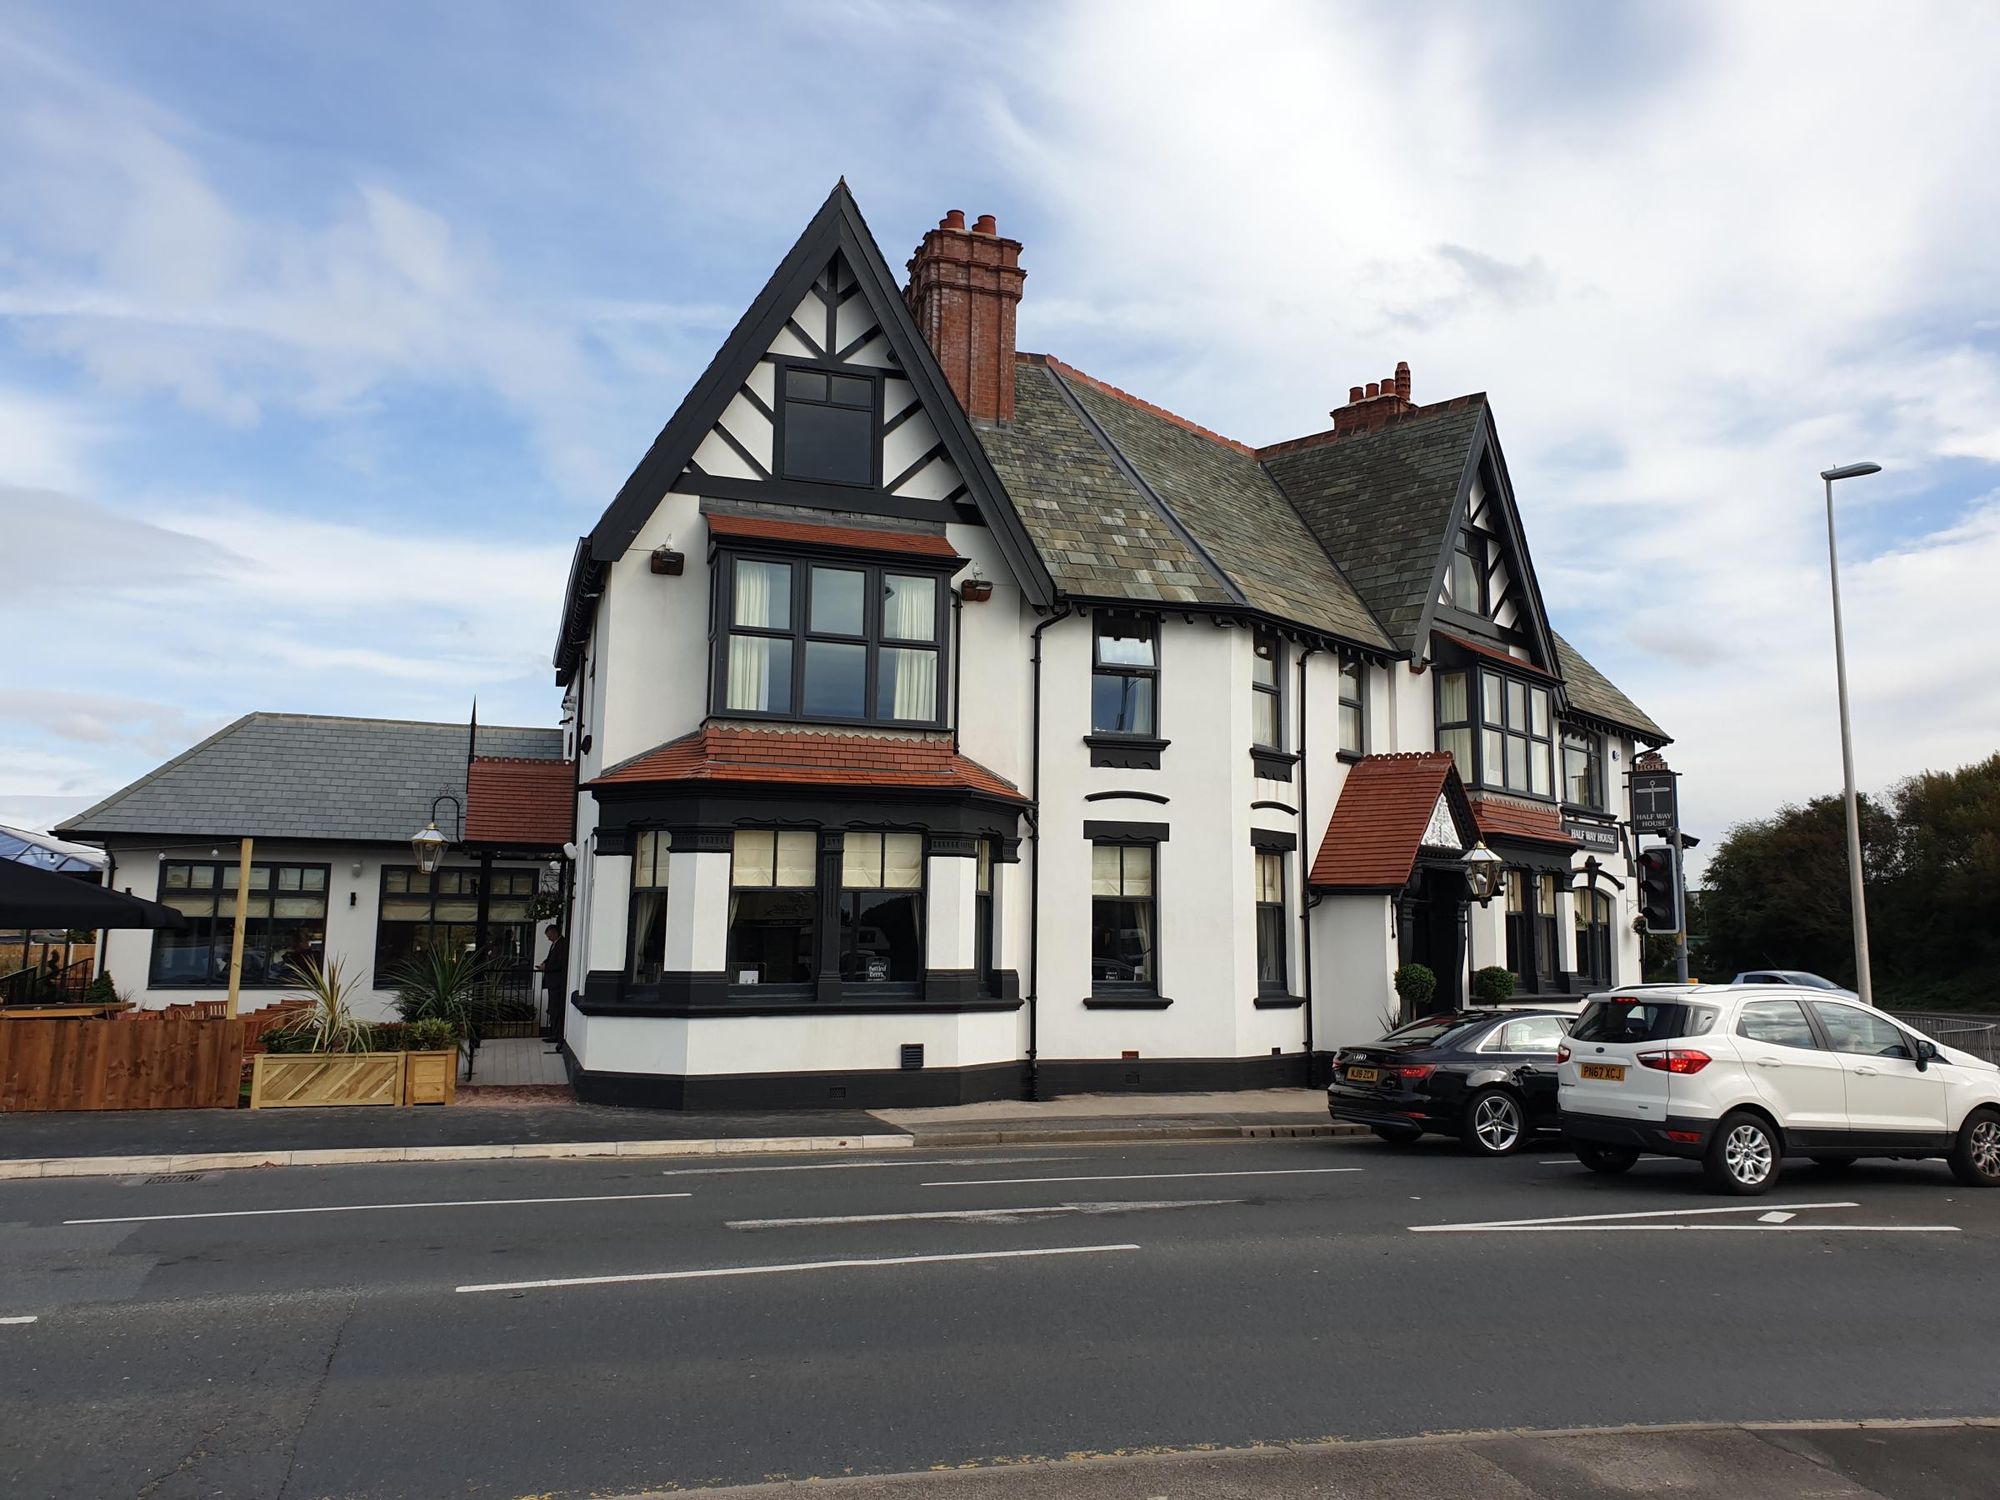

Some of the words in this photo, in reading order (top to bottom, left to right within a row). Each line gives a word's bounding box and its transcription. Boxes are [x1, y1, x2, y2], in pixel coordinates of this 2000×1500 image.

[1656, 812, 1672, 820] WAY
[1571, 828, 1585, 840] HALF
[1585, 831, 1597, 842] WAY
[1597, 832, 1615, 845] HOUSE
[1583, 1066, 1603, 1079] PN67
[1605, 1067, 1622, 1080] XCJ
